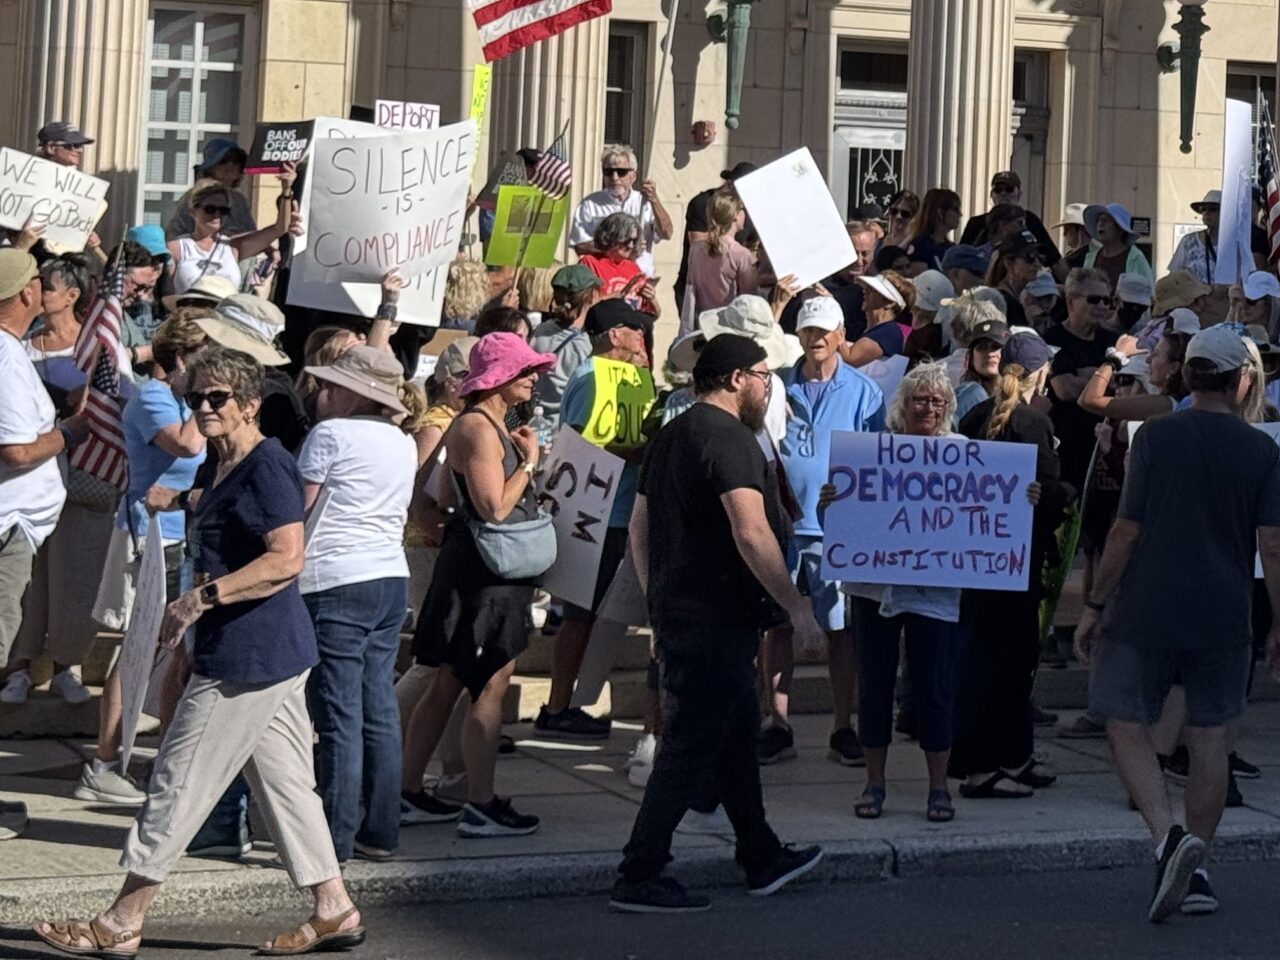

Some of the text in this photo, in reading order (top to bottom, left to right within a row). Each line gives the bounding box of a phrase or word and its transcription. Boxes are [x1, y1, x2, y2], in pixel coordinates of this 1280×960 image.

[378, 102, 438, 130] DEPORT
[264, 140, 288, 151] OFF
[266, 129, 297, 141] BANS
[4, 152, 97, 201] WE WILL
[327, 133, 471, 196] SILENCE
[32, 198, 63, 225] GO
[314, 210, 460, 268] COMPLIANCE
[878, 432, 985, 467] HONOR
[829, 465, 1020, 505] DEMOCRACY
[888, 505, 1011, 539] AND THE
[826, 543, 1027, 577] CONSTITUTION
